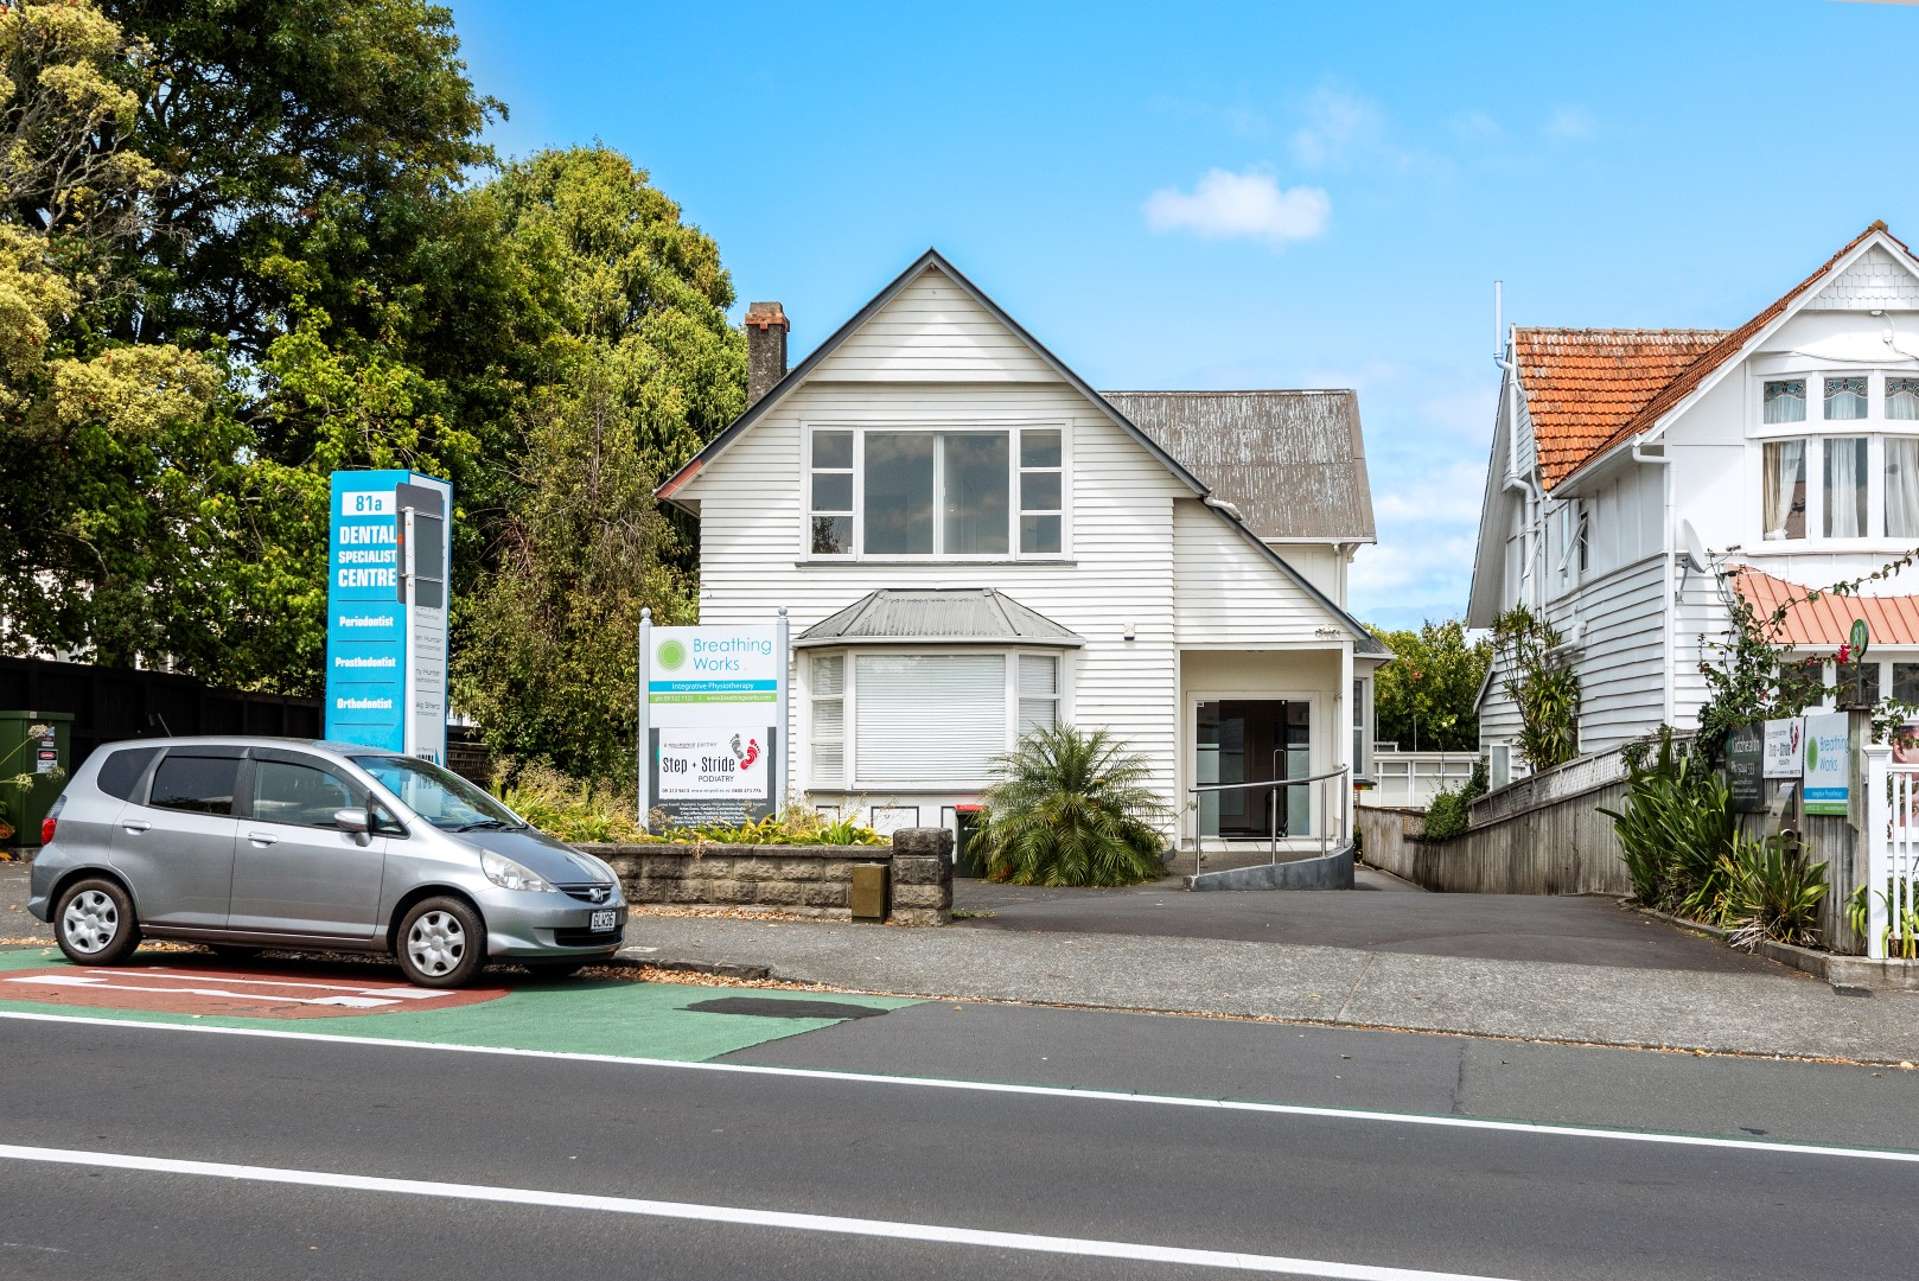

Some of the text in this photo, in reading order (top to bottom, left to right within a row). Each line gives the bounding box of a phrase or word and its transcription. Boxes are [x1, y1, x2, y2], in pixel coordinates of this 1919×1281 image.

[355, 495, 382, 511] 81a
[339, 525, 397, 545] DENTAL
[338, 549, 397, 564] SPECIALIST
[338, 568, 397, 588] CENTRE
[339, 616, 394, 627] Periodontist
[693, 637, 772, 656] Breathing
[335, 656, 396, 668] Prosthodontist
[693, 656, 740, 671] Works
[672, 681, 755, 691] Integrative Physiotherapy
[336, 698, 393, 709] Orthodontist
[662, 757, 688, 775] Step
[701, 756, 735, 773] Stride
[698, 775, 735, 783] PODIATRY
